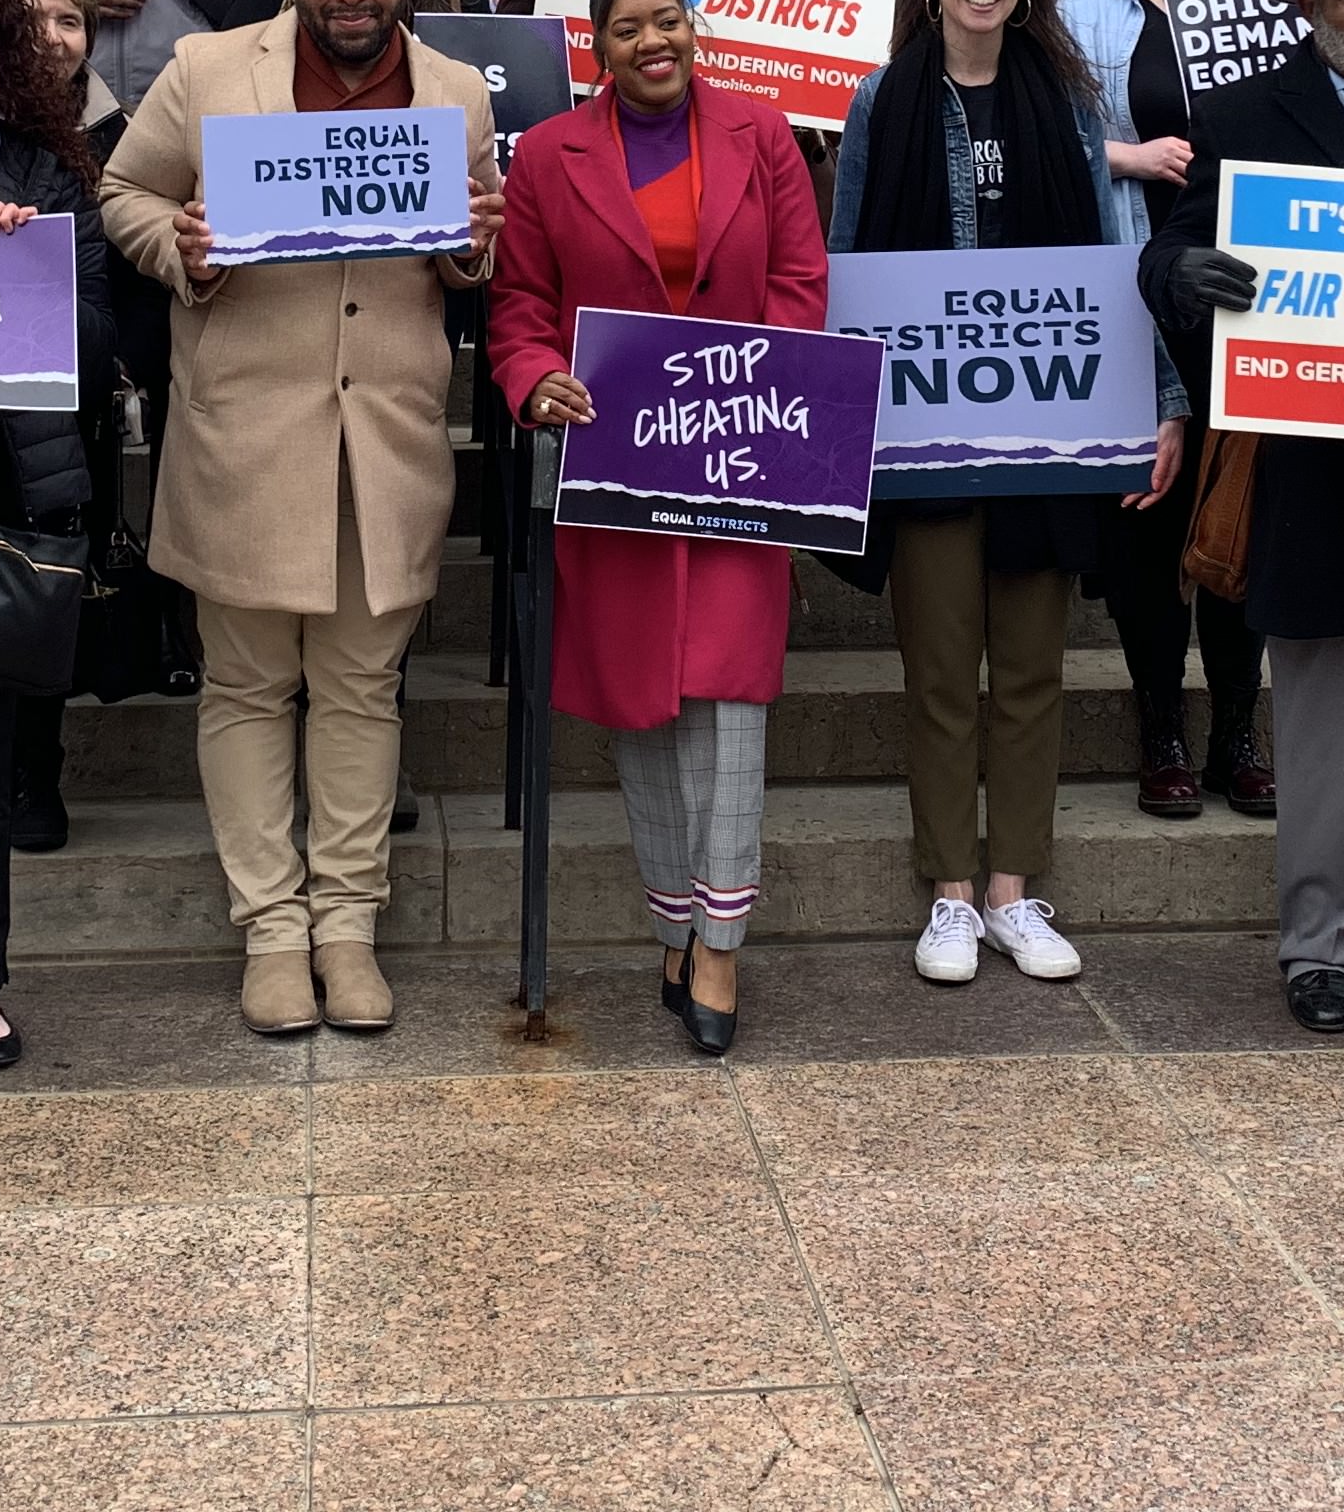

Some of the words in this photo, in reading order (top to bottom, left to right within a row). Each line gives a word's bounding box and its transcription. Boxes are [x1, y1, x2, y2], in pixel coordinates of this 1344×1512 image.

[566, 31, 594, 49] ND
[693, 50, 804, 80] ANDERING
[810, 66, 864, 90] NOW
[325, 124, 429, 151] EQUAL
[255, 152, 430, 182] DISTRICTS
[322, 181, 430, 216] NOW
[945, 287, 1099, 318] EQUAL
[1257, 268, 1342, 318] FAIR
[663, 338, 769, 386] STOP
[891, 354, 1101, 406] NOW
[1235, 356, 1288, 379] END
[634, 386, 809, 447] CHEATING
[706, 446, 766, 489] US.
[652, 512, 694, 525] EQUAL
[697, 516, 768, 533] DISTRICTS
